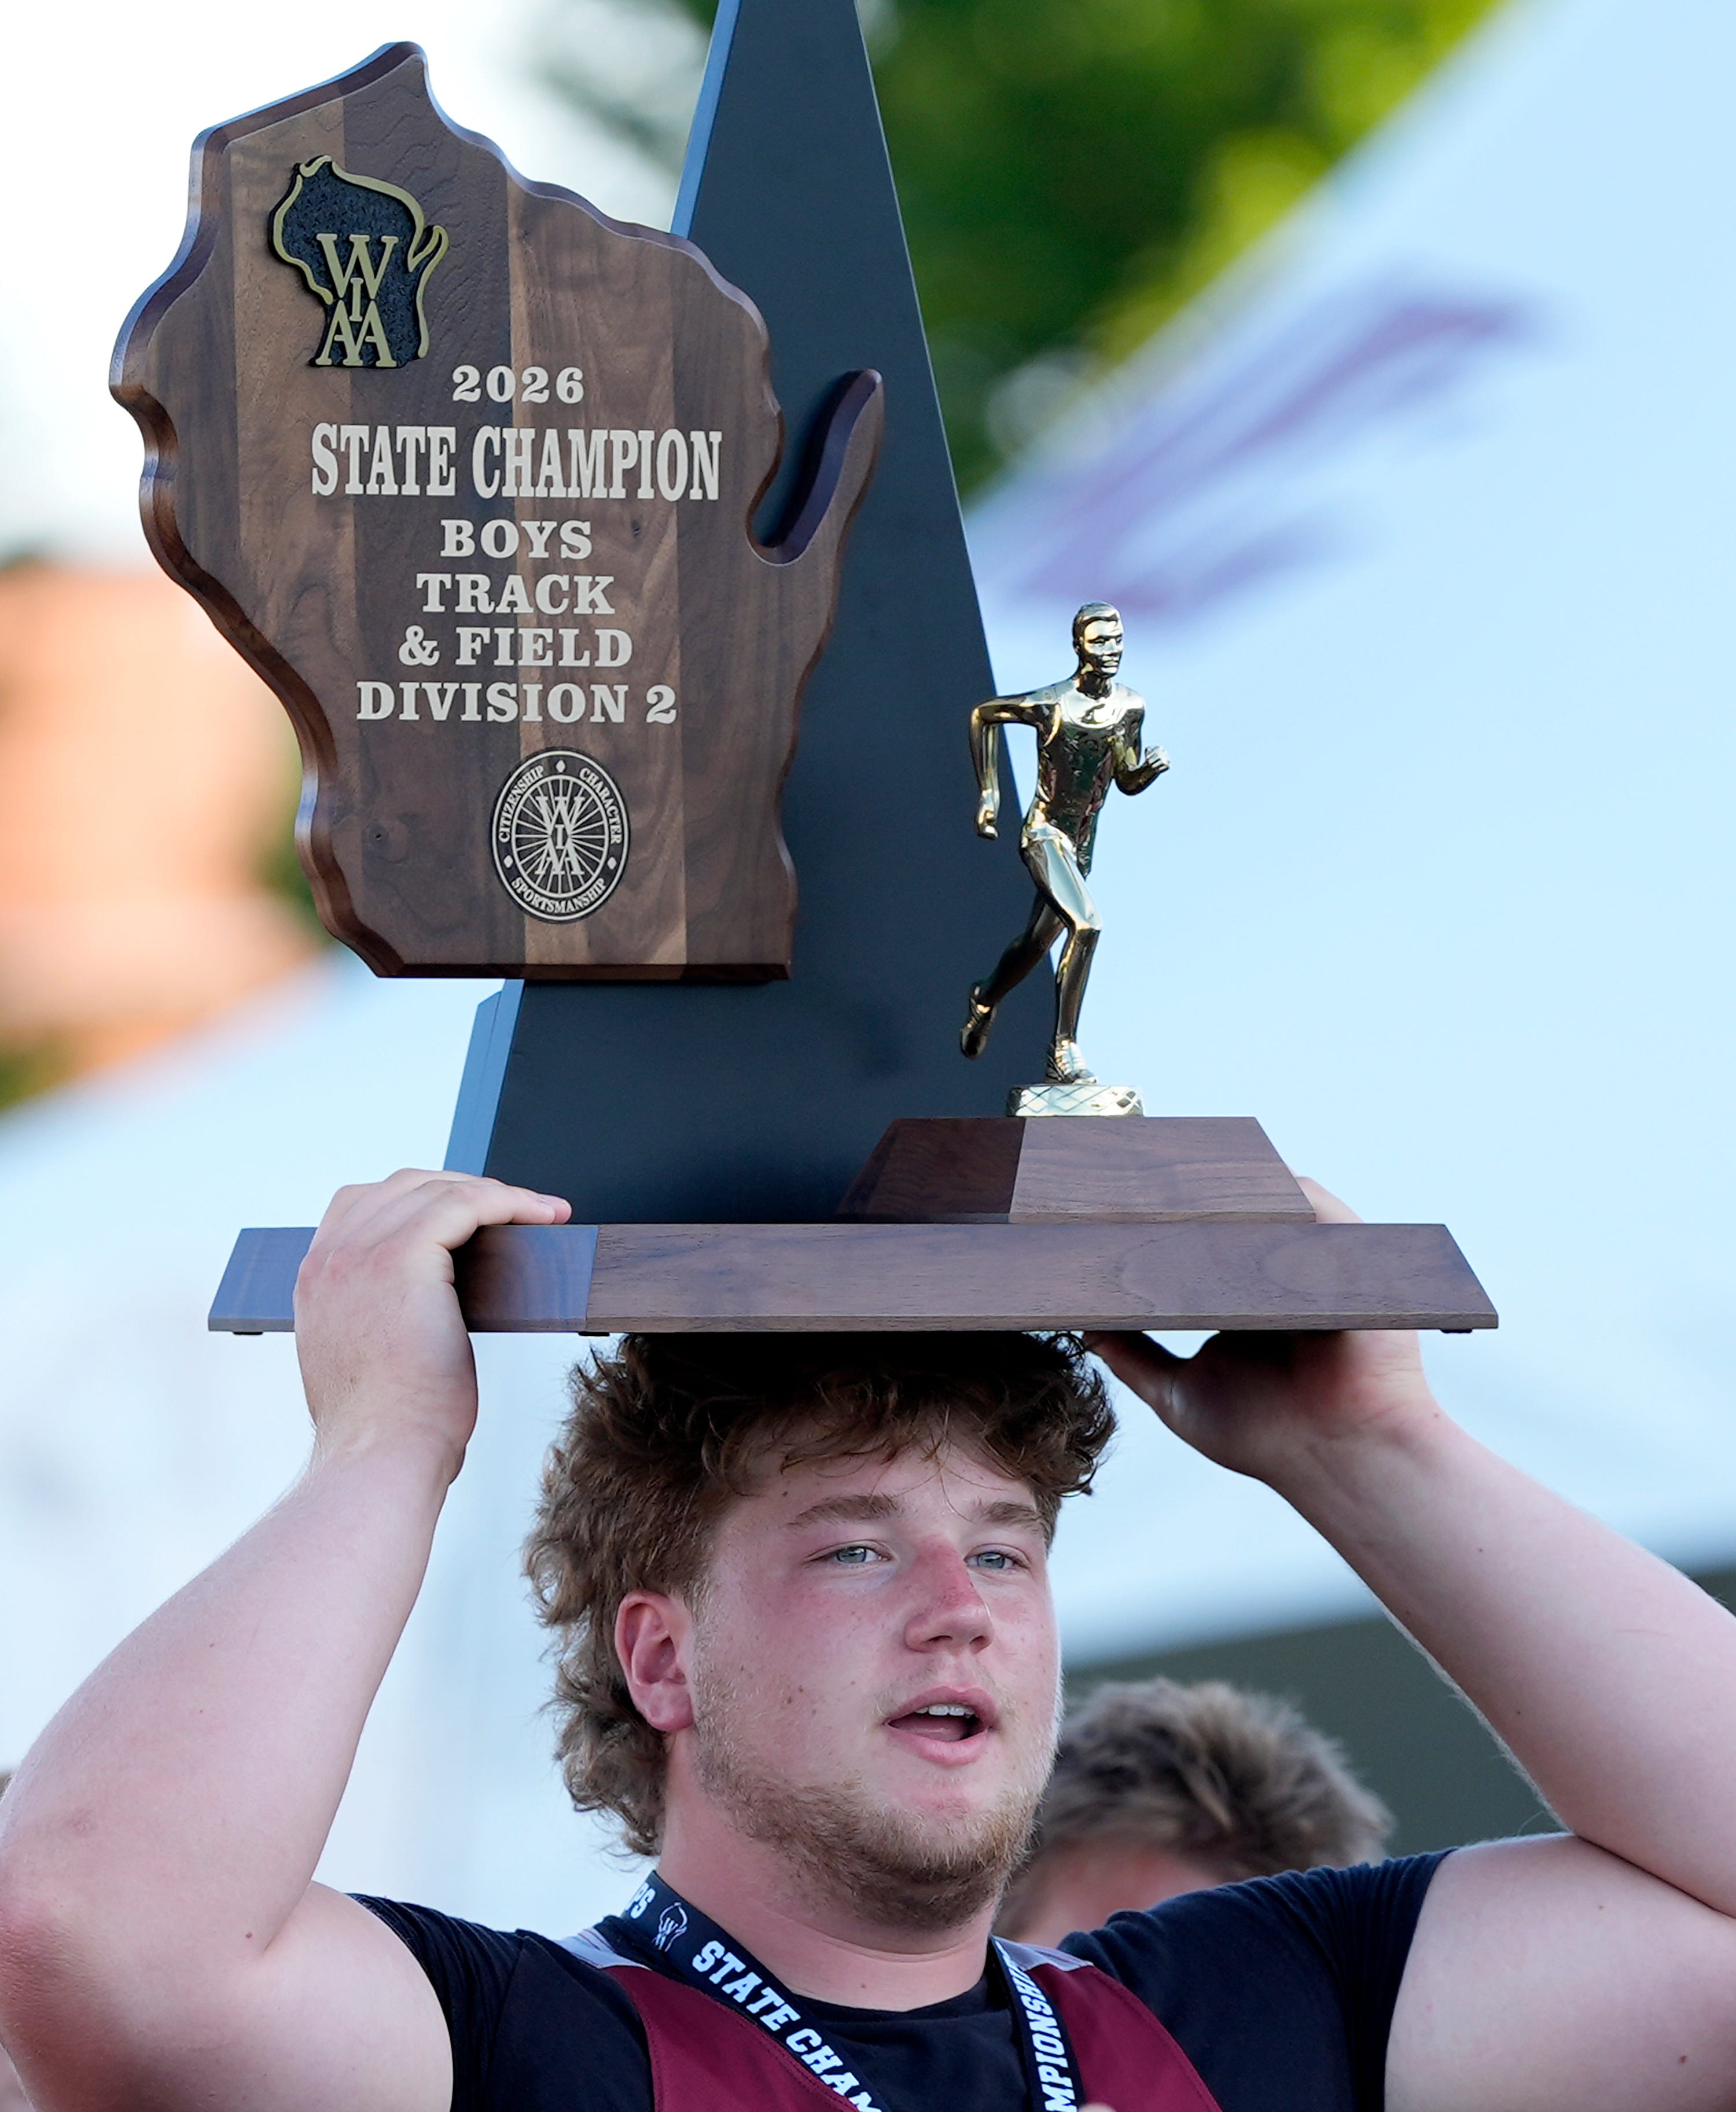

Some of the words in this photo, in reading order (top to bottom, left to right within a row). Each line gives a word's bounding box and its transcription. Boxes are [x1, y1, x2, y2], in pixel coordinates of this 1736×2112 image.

[452, 365, 584, 404] 2026
[311, 423, 457, 497] STATE
[472, 425, 723, 502] CHAMPION
[440, 519, 593, 560] BOYS
[416, 573, 616, 615] TRACK
[398, 625, 440, 666] &
[455, 627, 633, 667] FIELD
[356, 681, 629, 723] DIVISION
[646, 685, 678, 724] 2
[498, 765, 545, 843] CITIZENSHIP
[579, 767, 623, 845] CHARACTER
[511, 876, 606, 914] SPORTSMANSHIP
[692, 1940, 801, 2032] STATE
